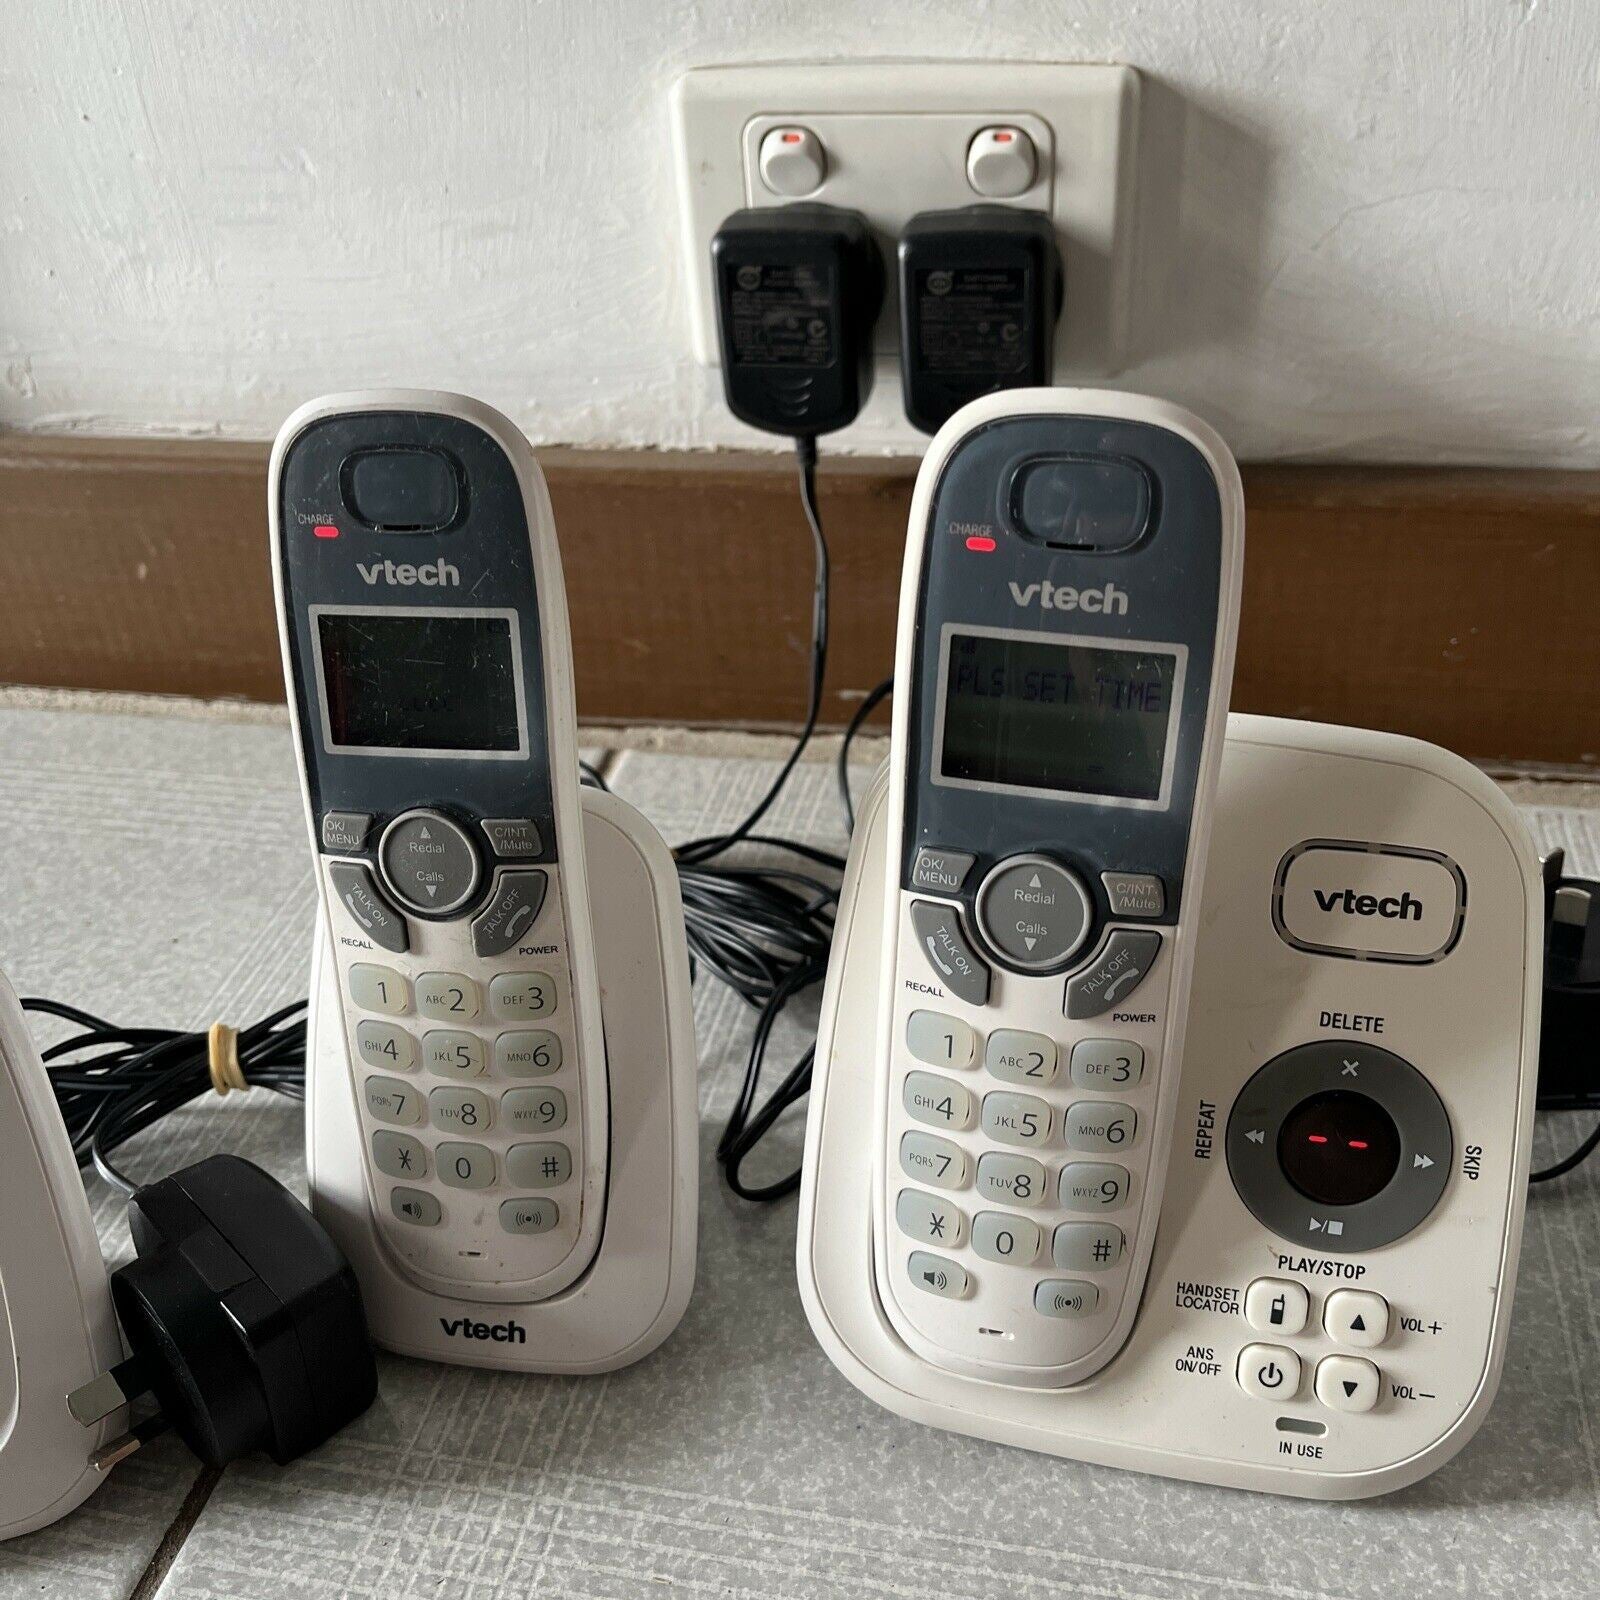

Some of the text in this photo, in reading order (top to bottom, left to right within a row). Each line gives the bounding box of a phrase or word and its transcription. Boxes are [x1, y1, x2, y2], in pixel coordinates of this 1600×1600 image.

[298, 513, 335, 525] CHARGE
[950, 521, 993, 536] CHARGE
[356, 557, 460, 586] vtech
[1008, 580, 1129, 616] vtech
[956, 664, 1162, 713] PLS SET TIME
[327, 833, 359, 846] MENU
[495, 827, 528, 838] C/INT
[409, 842, 445, 853] Redial
[921, 856, 943, 870] OK/
[416, 870, 445, 882] Calls
[919, 869, 958, 886] MENU
[350, 882, 388, 927] TALK ON
[1013, 889, 1056, 906] Redial
[1313, 888, 1423, 921] vtech
[482, 888, 521, 936] TALK OFF
[1015, 920, 1048, 935] Calls
[341, 937, 374, 949] RECALL
[519, 945, 559, 956] POWER
[936, 925, 972, 976] TALK ON
[1080, 948, 1130, 996] TALK OFF
[377, 981, 387, 1004] 1
[425, 989, 465, 1012] ABC 2
[503, 986, 545, 1010] DEF 3
[905, 980, 945, 998] RECALL
[1112, 1013, 1156, 1023] POWER
[1319, 1010, 1385, 1033] DELETE
[364, 1038, 399, 1061] GHI 4
[433, 1046, 471, 1069] JKL 5
[507, 1044, 550, 1067] MNO 6
[944, 1034, 954, 1059] 1
[999, 1052, 1044, 1078] ABC 2
[1086, 1057, 1131, 1082] DEF 3
[391, 1093, 406, 1116] 7
[440, 1103, 477, 1126] TUV 8
[513, 1101, 556, 1124] WXYZ 9
[914, 1094, 954, 1121] GHI 4
[994, 1113, 1038, 1137] JKL 5
[1078, 1119, 1126, 1144] MNO 6
[1195, 1099, 1217, 1159] REPEAT
[455, 1157, 472, 1179] 0
[909, 1152, 952, 1177] PQRS 7
[1463, 1144, 1483, 1181] SKIP
[989, 1174, 1031, 1198] TUV 8
[1072, 1180, 1119, 1204] WXYZ 9
[995, 1231, 1014, 1255] 0
[1277, 1255, 1366, 1280] PLAY/STOP
[1176, 1281, 1240, 1301] HANDSET
[1175, 1295, 1240, 1315] LOCATOR
[439, 1317, 526, 1344] vtech
[1186, 1345, 1214, 1360] ANS
[1175, 1358, 1222, 1376] ON/OFF
[1279, 1441, 1323, 1459] IN USE
